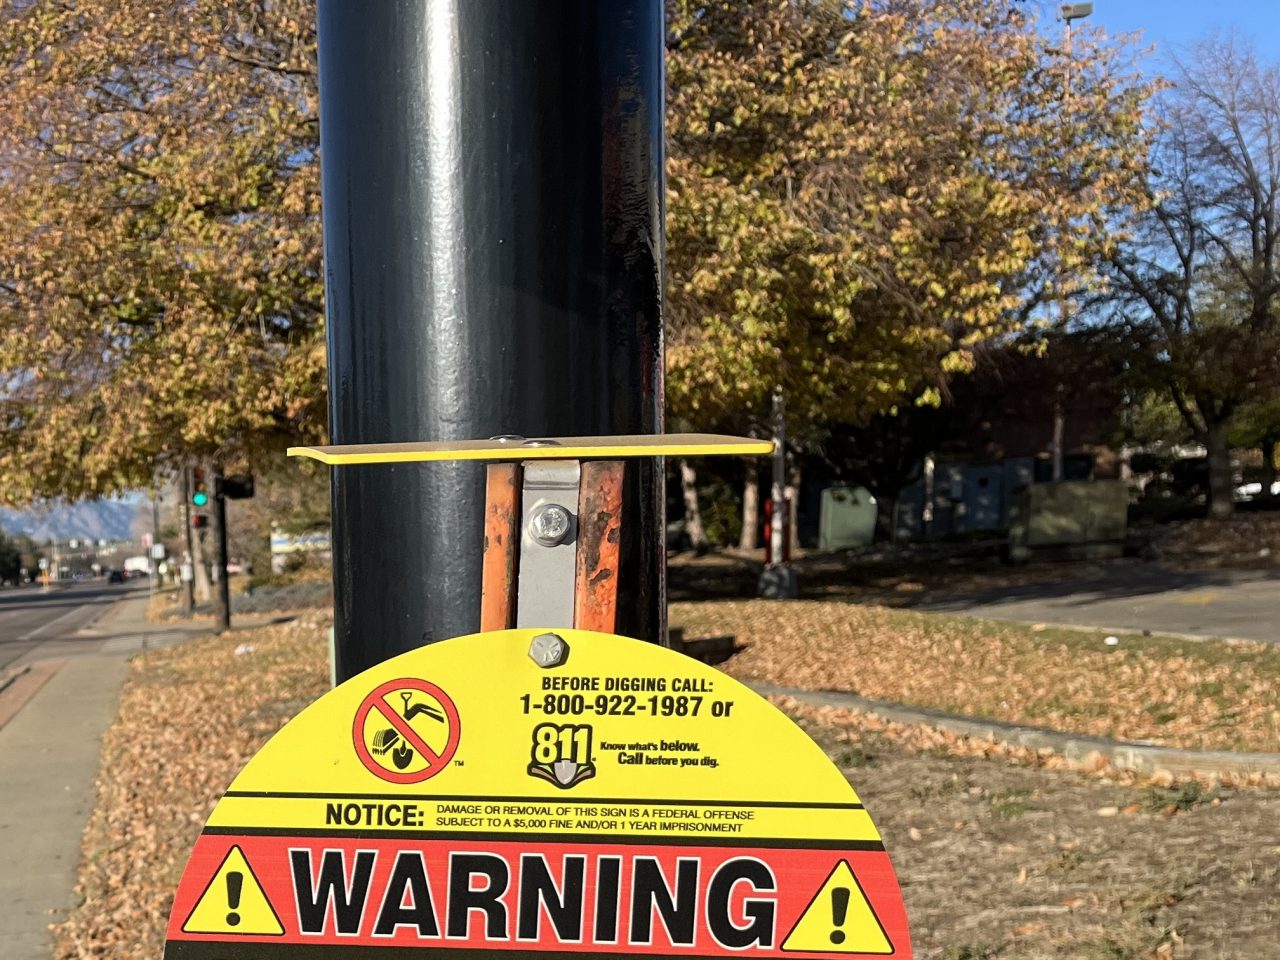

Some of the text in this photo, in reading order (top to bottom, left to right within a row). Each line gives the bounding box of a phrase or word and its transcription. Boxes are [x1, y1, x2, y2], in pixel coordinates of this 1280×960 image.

[542, 677, 714, 692] BEFORE DIGGING CALL:
[520, 694, 734, 717] 1-800-922-1987 or
[533, 723, 593, 765] 811
[600, 740, 700, 752] Know what's below.
[617, 752, 720, 768] Call before you dig.
[325, 803, 424, 827] NOTICE:
[436, 804, 755, 820] DAMAGE OR REMOVAL OF THIS SIGN IS A FEDERAL OFFENSE
[436, 817, 744, 832] SUBJECT TO A $5,000 FINE AND/OR 1 YEAR IMPRISONMENT
[288, 847, 778, 950] WARNING
